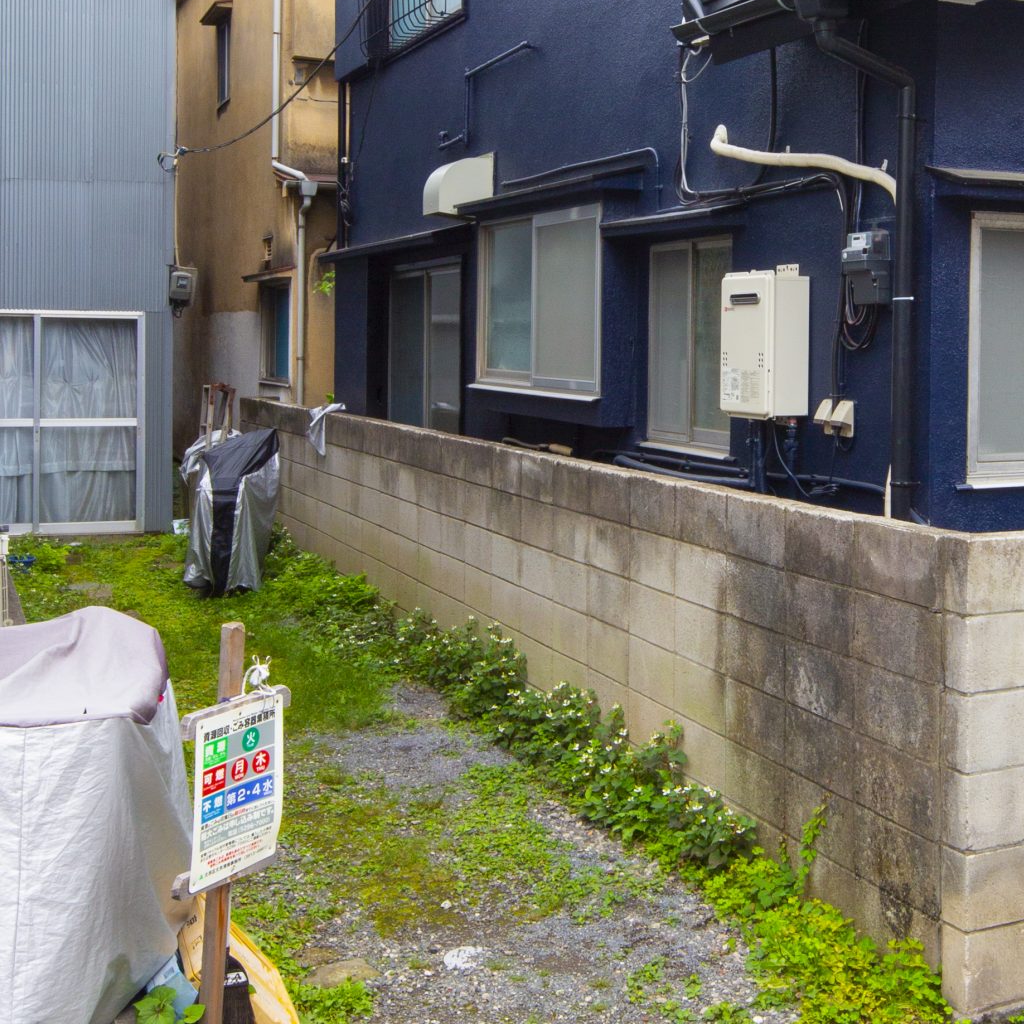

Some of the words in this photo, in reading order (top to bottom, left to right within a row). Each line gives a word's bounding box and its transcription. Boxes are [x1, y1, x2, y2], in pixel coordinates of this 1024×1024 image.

[246, 731, 256, 745] 火
[235, 759, 245, 774] 月
[255, 752, 267, 766] 木
[203, 767, 225, 785] 可燃
[202, 794, 224, 813] 不燃
